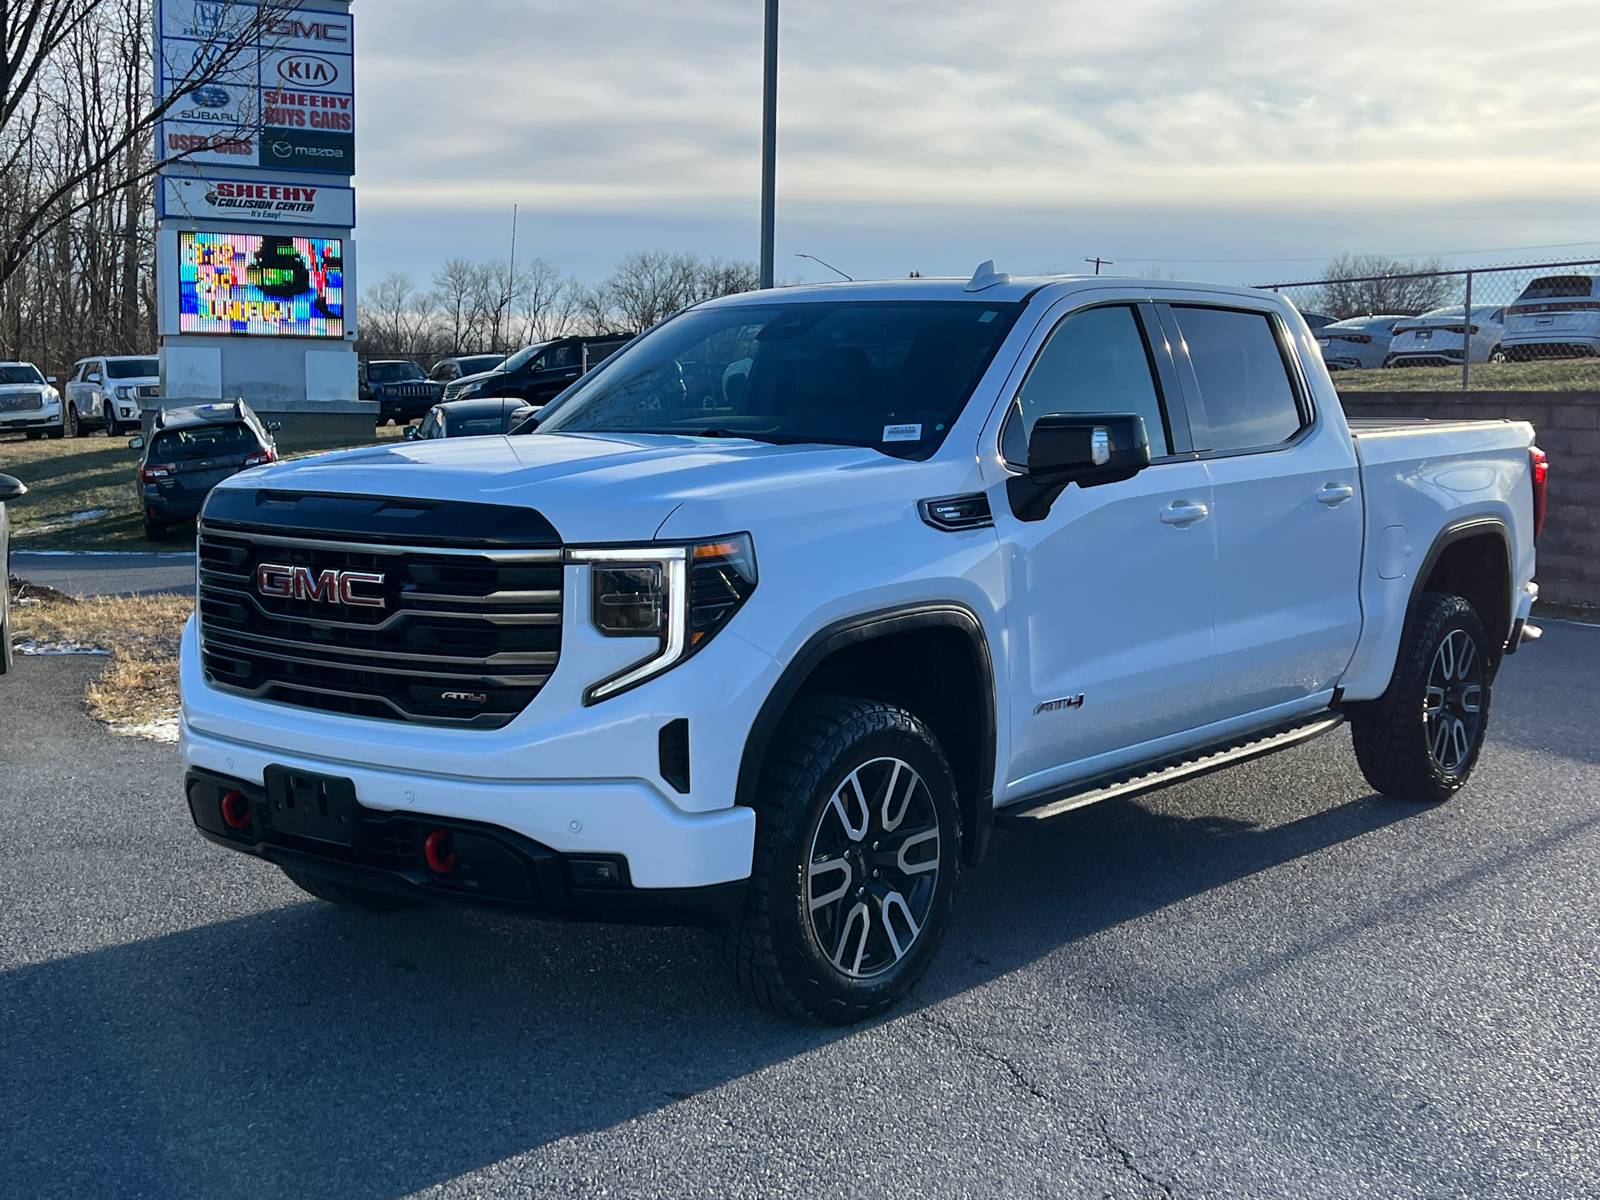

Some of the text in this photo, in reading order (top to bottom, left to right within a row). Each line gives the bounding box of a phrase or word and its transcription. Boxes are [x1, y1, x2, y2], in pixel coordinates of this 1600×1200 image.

[182, 27, 237, 40] HONDA
[267, 18, 347, 43] GMC
[288, 60, 329, 81] KIA
[263, 90, 351, 110] SHEEHY
[181, 110, 240, 122] SUBARU
[264, 106, 352, 131] BUYS CARS
[217, 183, 317, 202] SHEEHY
[217, 198, 315, 212] COLLISION CENTER
[250, 210, 282, 220] It's Easy!
[257, 563, 386, 608] GMC
[441, 691, 486, 704] AT4
[1033, 692, 1085, 716] AT4
